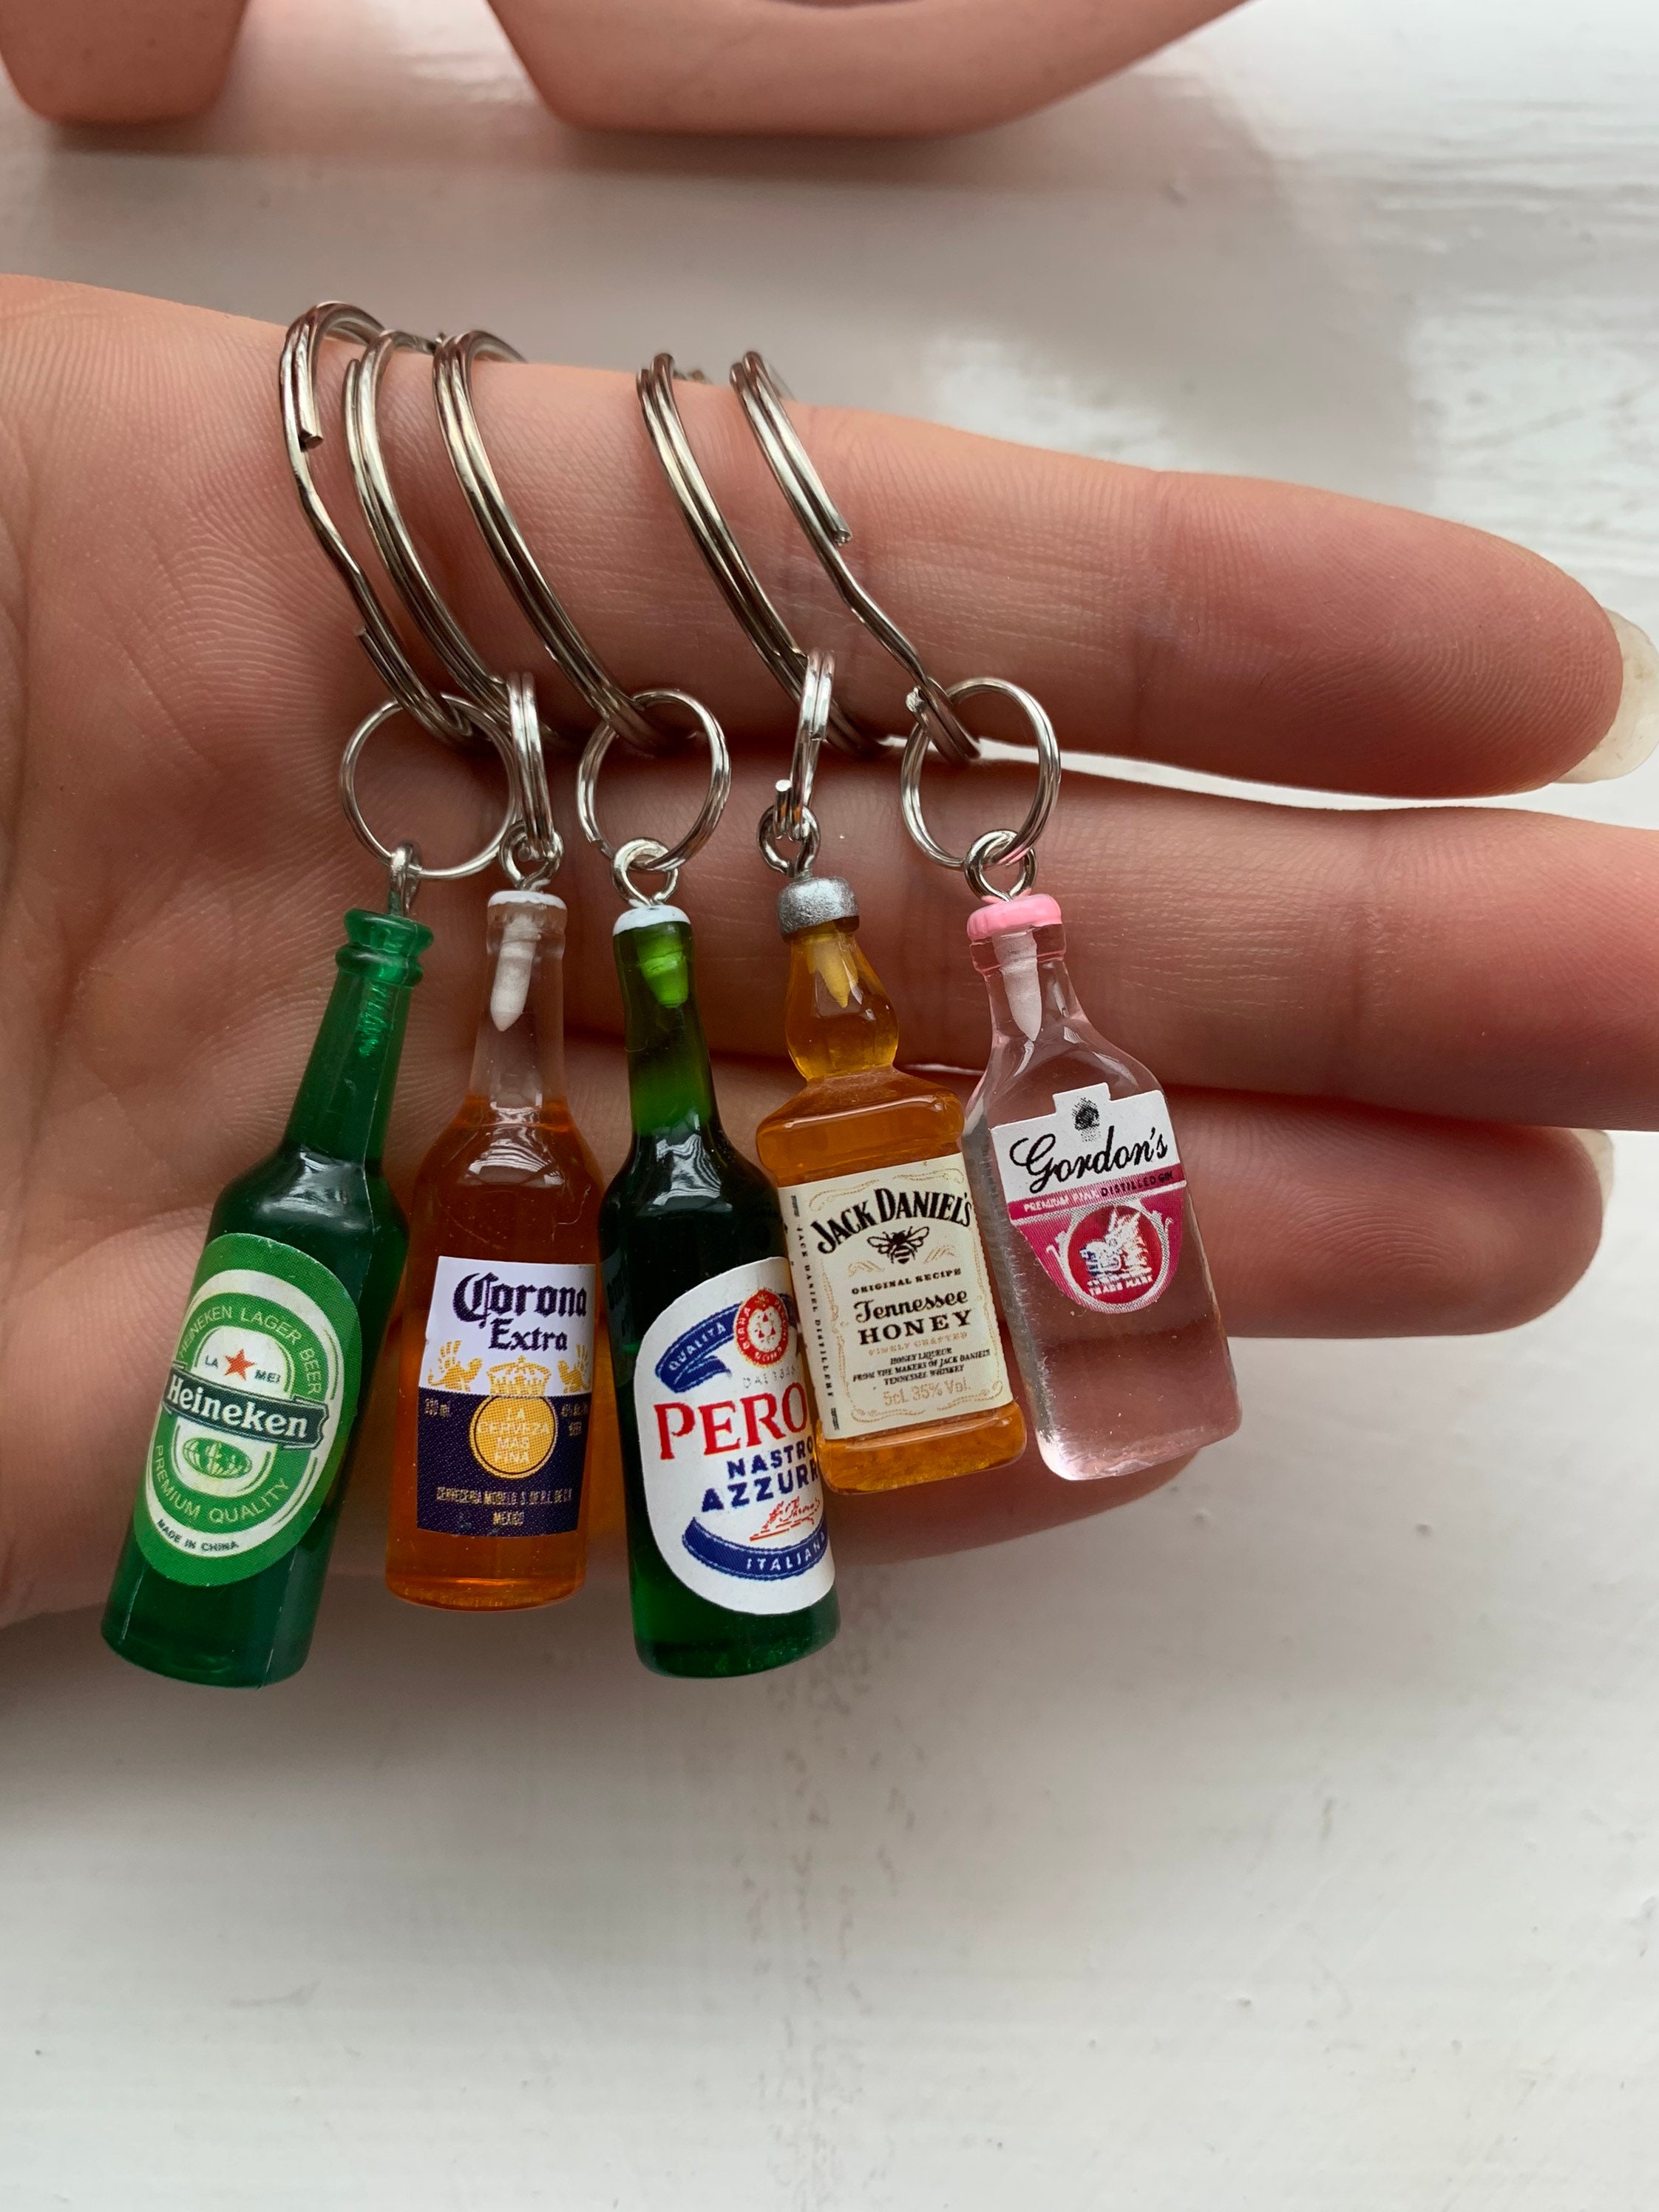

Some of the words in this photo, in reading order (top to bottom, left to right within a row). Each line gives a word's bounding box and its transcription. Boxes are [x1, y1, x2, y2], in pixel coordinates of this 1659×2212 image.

[1009, 1125, 1167, 1194] Gordon's
[1023, 1195, 1069, 1212] PREMIUM
[1101, 1176, 1156, 1197] DISTILLED
[810, 1200, 878, 1255] JACK
[874, 1187, 973, 1227] DANIEL'S
[852, 1278, 912, 1295] ORIGINAL
[915, 1267, 962, 1282] RECIPE
[452, 1271, 588, 1329] Corona
[853, 1290, 968, 1323] Tennessee
[488, 1317, 568, 1351] Extra
[858, 1309, 972, 1346] HONEY
[240, 1307, 302, 1346] LAGER
[299, 1347, 322, 1395] BEER
[939, 1355, 958, 1368] JACK
[166, 1374, 308, 1439] Heineken
[910, 1382, 943, 1402] 35%
[506, 1408, 526, 1421] LA
[726, 1435, 813, 1479] NASTRO
[155, 1444, 201, 1519] PREMIUM
[208, 1478, 289, 1524] QUALITY
[157, 1518, 183, 1544] MADE
